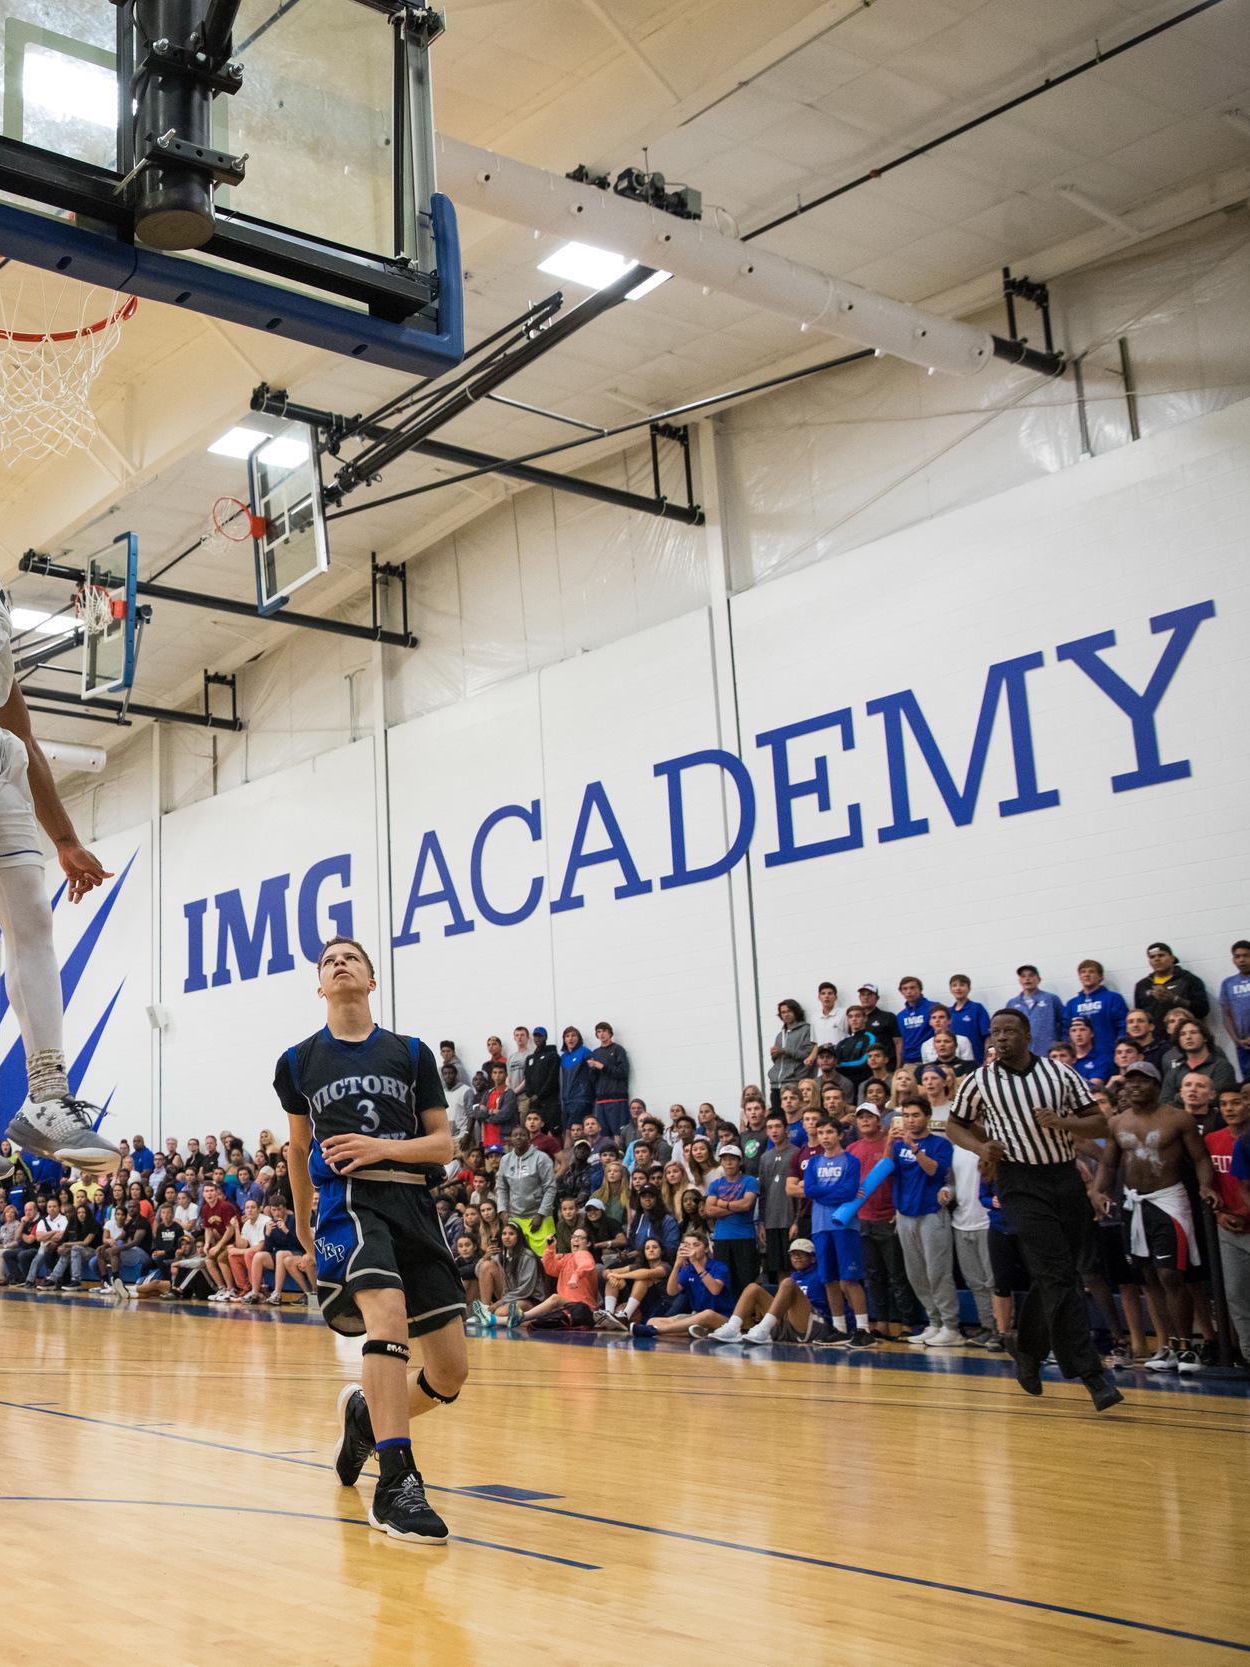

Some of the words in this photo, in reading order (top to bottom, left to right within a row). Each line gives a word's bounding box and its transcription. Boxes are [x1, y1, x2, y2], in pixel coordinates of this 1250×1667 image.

[183, 853, 355, 994] IMG
[392, 599, 1216, 949] ACADEMY
[312, 1074, 410, 1115] VICTORY
[356, 1099, 381, 1133] 3
[817, 1167, 842, 1178] IMG
[314, 1236, 345, 1263] VRP
